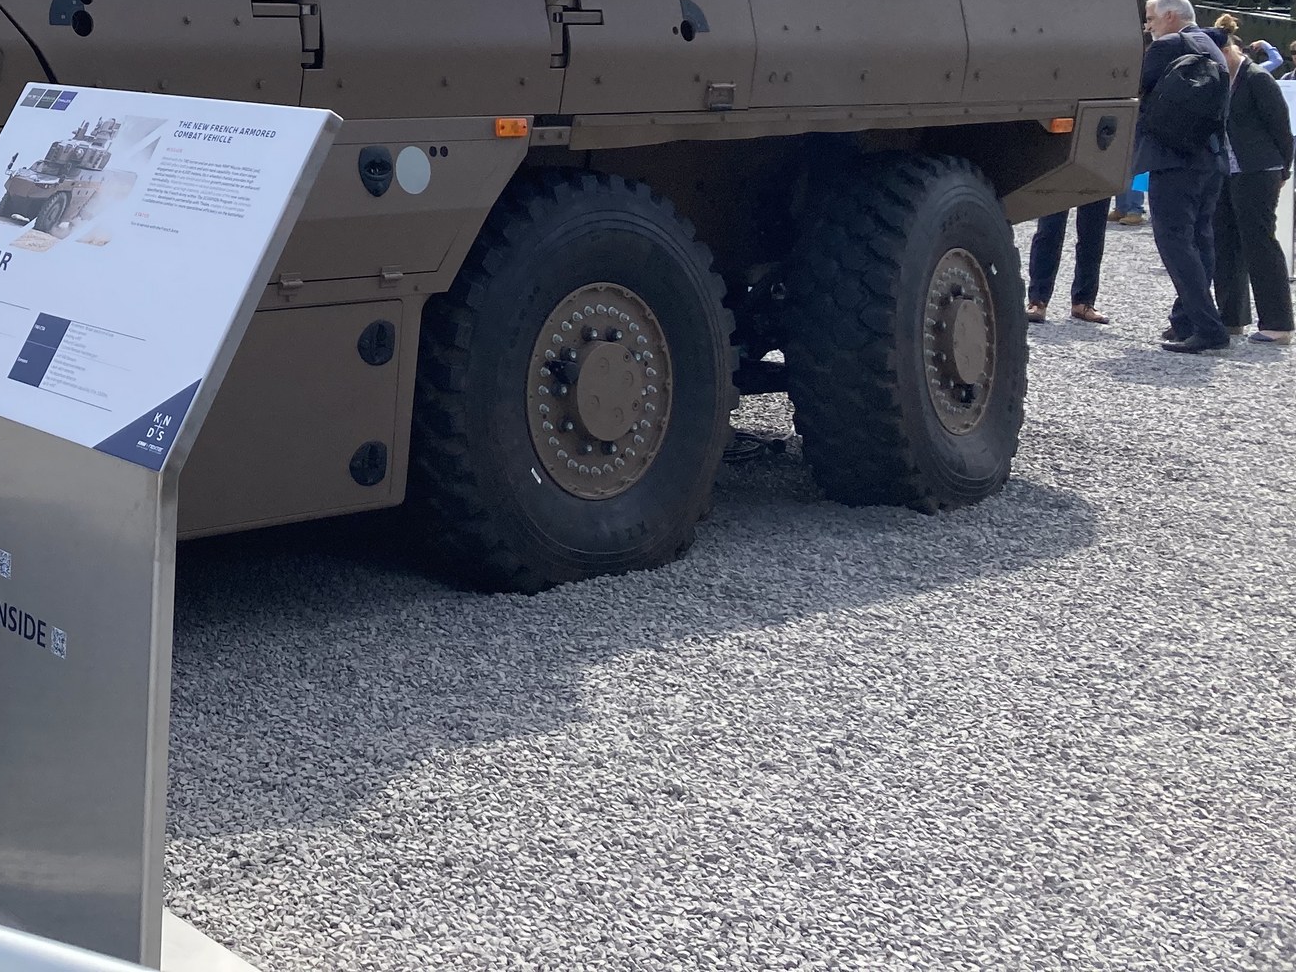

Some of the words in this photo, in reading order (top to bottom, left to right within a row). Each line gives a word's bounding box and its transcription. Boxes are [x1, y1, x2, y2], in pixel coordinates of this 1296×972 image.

[173, 130, 202, 140] COMBAT
[203, 134, 233, 144] VEHICLE
[178, 120, 192, 129] THE
[193, 122, 210, 131] NEW
[209, 124, 239, 134] FRENCH
[239, 127, 277, 139] ARMORED
